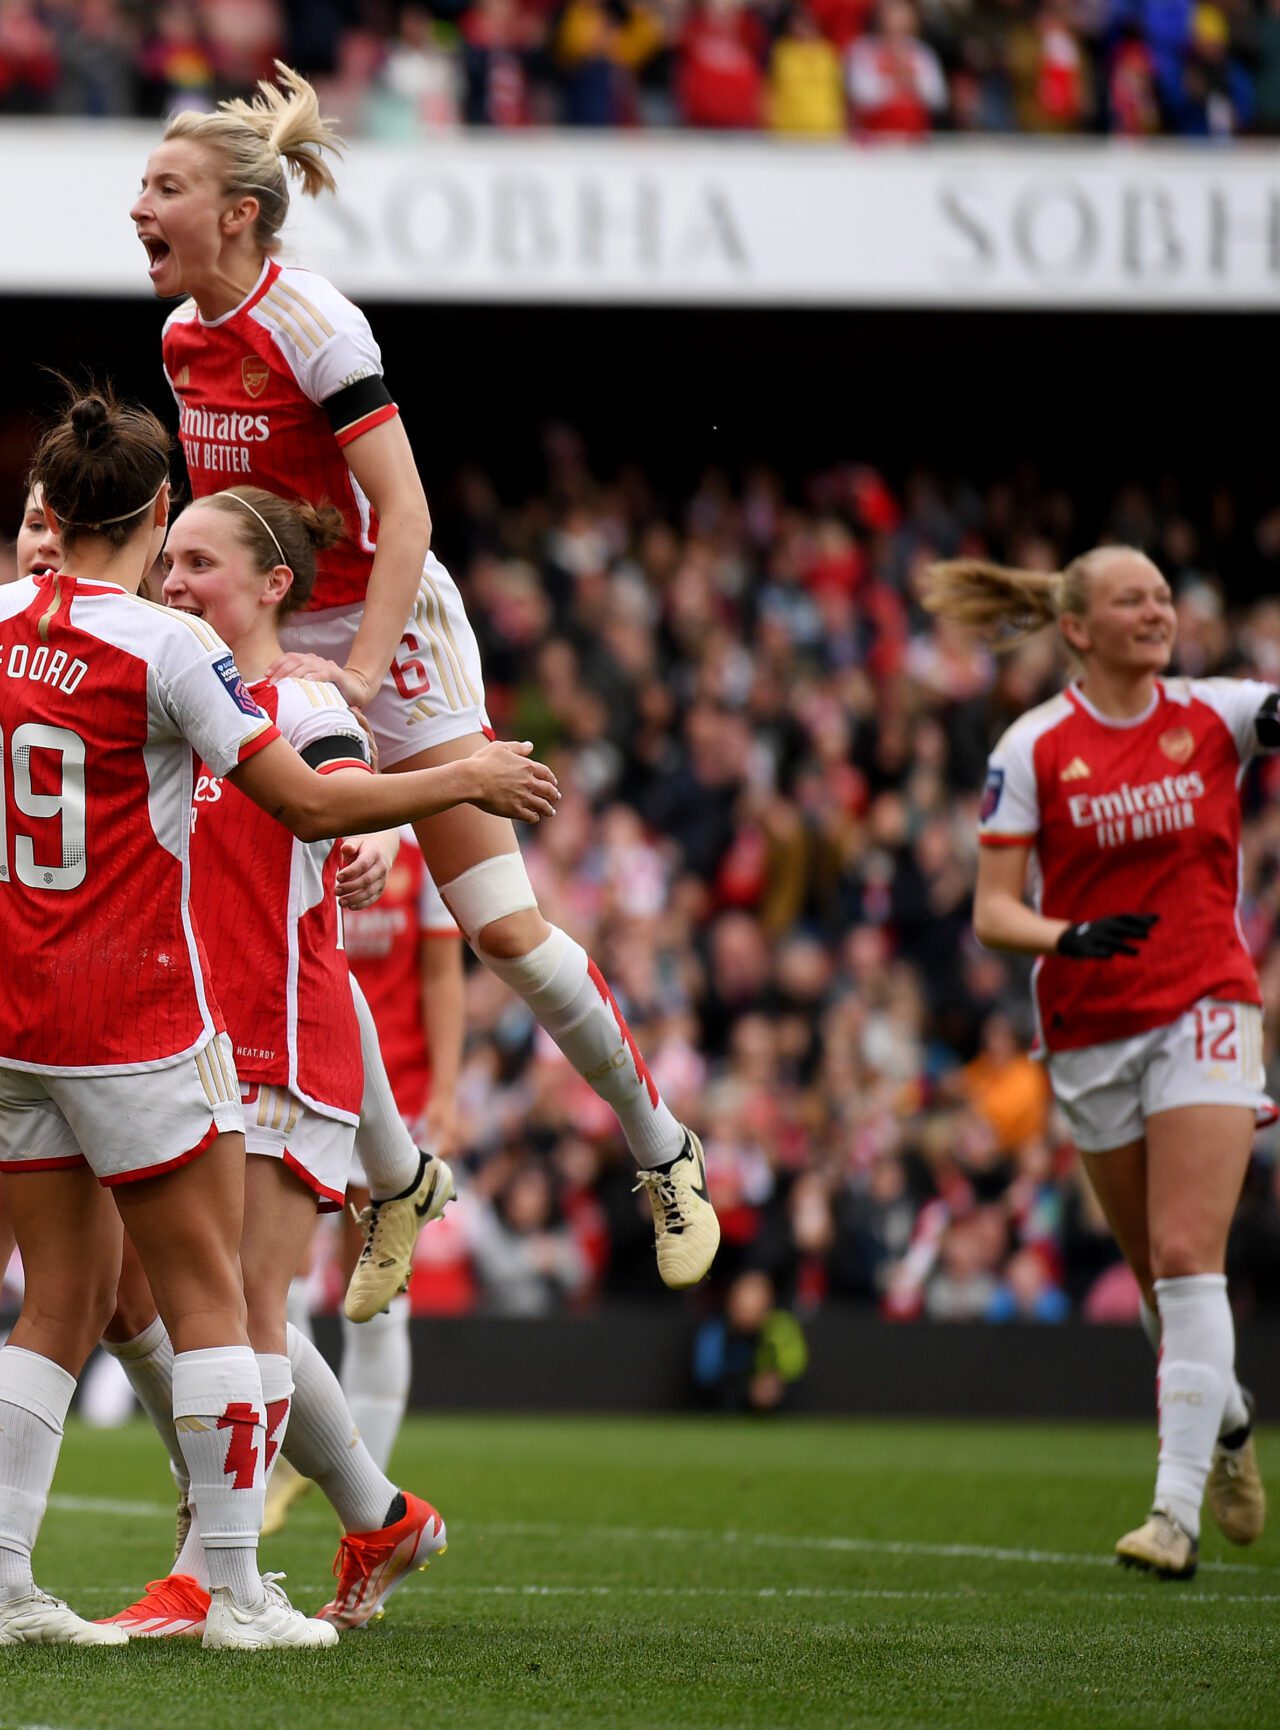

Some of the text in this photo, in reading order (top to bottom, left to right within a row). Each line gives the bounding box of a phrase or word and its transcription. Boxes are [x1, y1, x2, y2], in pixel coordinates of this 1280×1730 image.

[182, 400, 270, 442] mirates
[204, 443, 252, 473] BETTER
[390, 632, 431, 698] 6
[1068, 770, 1204, 828] Emirates
[236, 1046, 276, 1060] HEAT.RDY
[1192, 1008, 1237, 1061] 12
